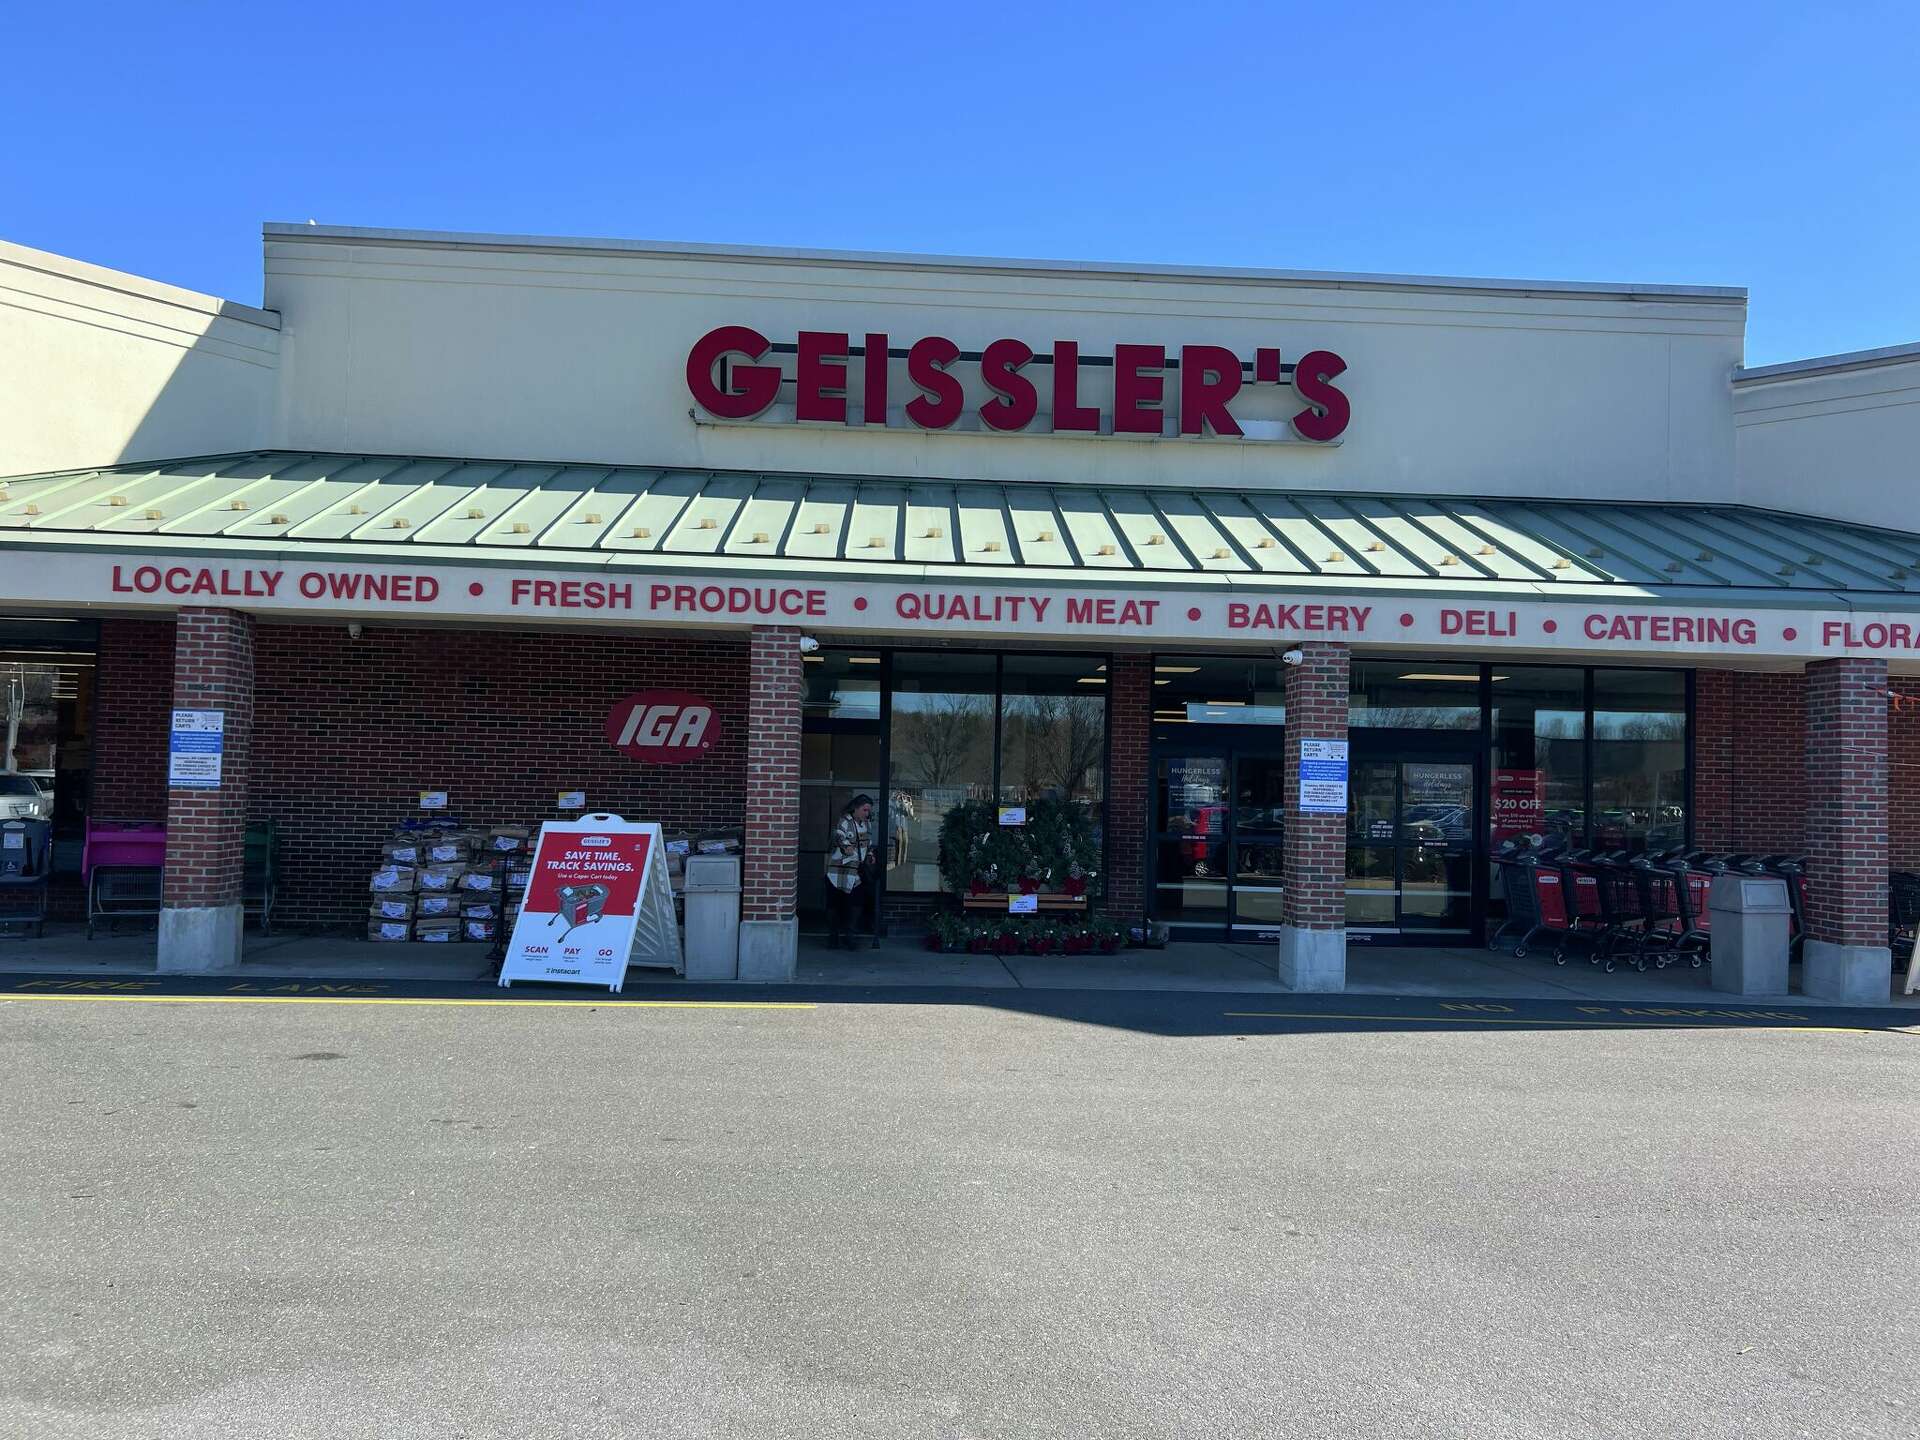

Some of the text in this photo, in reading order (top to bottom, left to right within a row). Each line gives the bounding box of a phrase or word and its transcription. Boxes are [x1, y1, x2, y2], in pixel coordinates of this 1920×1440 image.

[687, 326, 1350, 441] GEISSLER'S
[112, 566, 439, 603] LOCALLY OWNED
[511, 580, 825, 616] FRESH PRODUCE
[895, 593, 1160, 626] QUALITY MEAT
[1228, 603, 1372, 632] BAKERY
[1440, 610, 1517, 637] DELI
[1584, 614, 1756, 644] CATERING
[1823, 621, 1920, 649] FLOR
[616, 704, 712, 748] IGA
[1171, 767, 1221, 775] HUNGERLESS
[1495, 797, 1542, 810] $20 OFF
[547, 861, 635, 872] TRACK SAVINGS.
[564, 851, 621, 861] SAVE TIME.
[524, 945, 549, 953] SCAN
[563, 947, 581, 955] PAY
